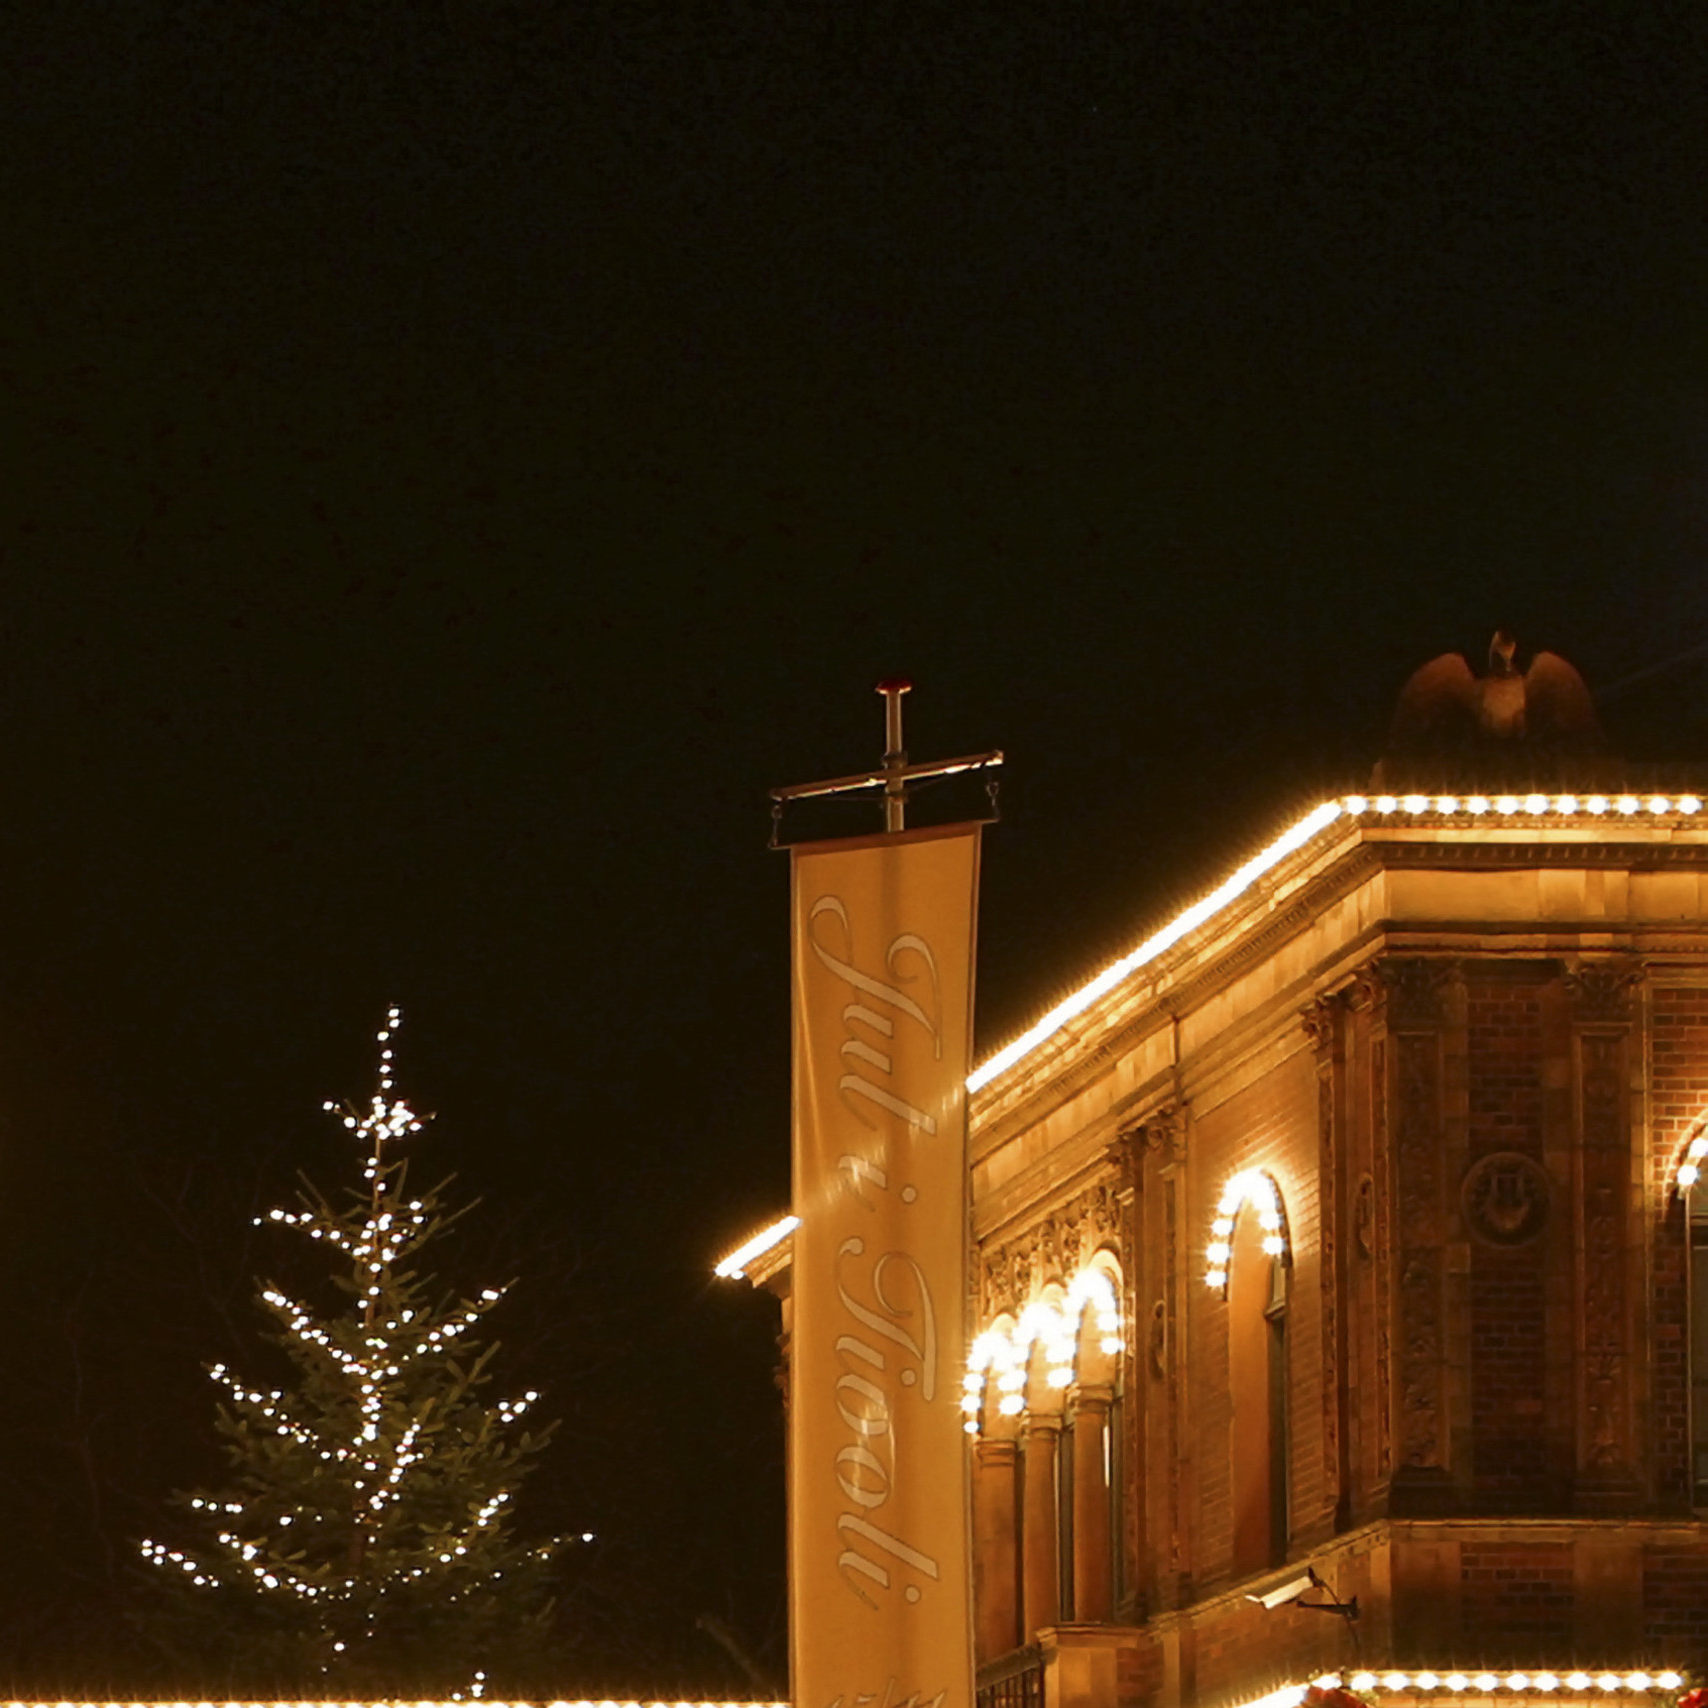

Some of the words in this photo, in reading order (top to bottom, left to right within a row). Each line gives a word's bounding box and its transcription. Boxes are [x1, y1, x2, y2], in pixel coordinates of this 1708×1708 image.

[808, 894, 943, 1136] Jul
[837, 1154, 917, 1212] i
[835, 1236, 941, 1612] Tivoli
